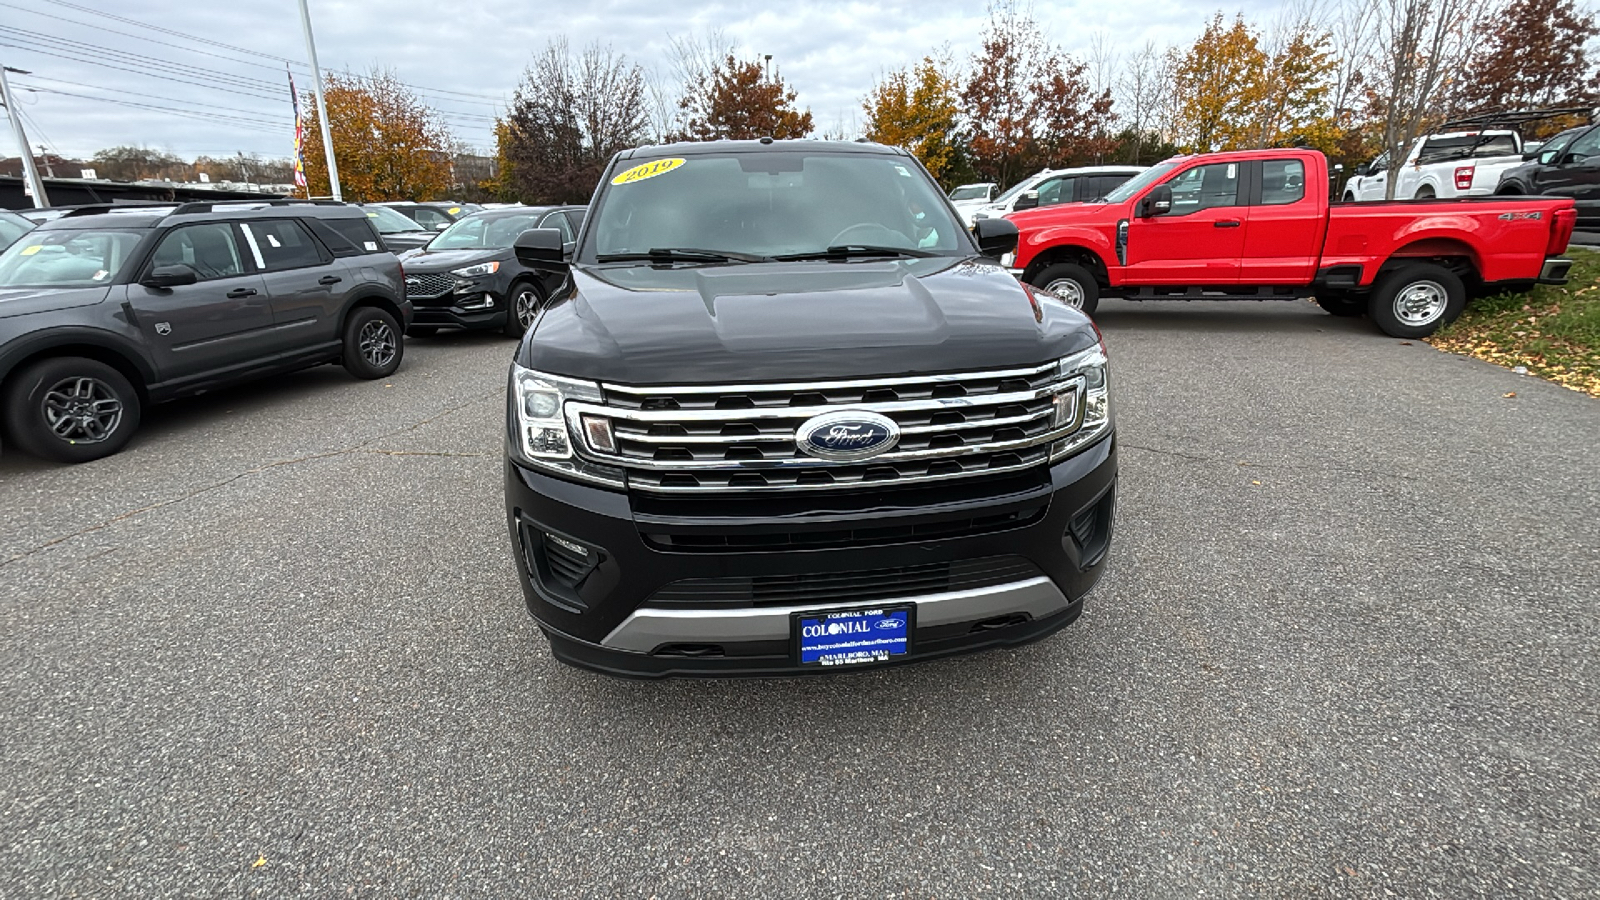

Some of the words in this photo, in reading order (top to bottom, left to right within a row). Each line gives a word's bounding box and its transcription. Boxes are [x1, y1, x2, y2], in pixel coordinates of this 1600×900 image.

[624, 160, 674, 182] 2019
[825, 425, 874, 447] Ford
[802, 620, 870, 638] COLONIAL
